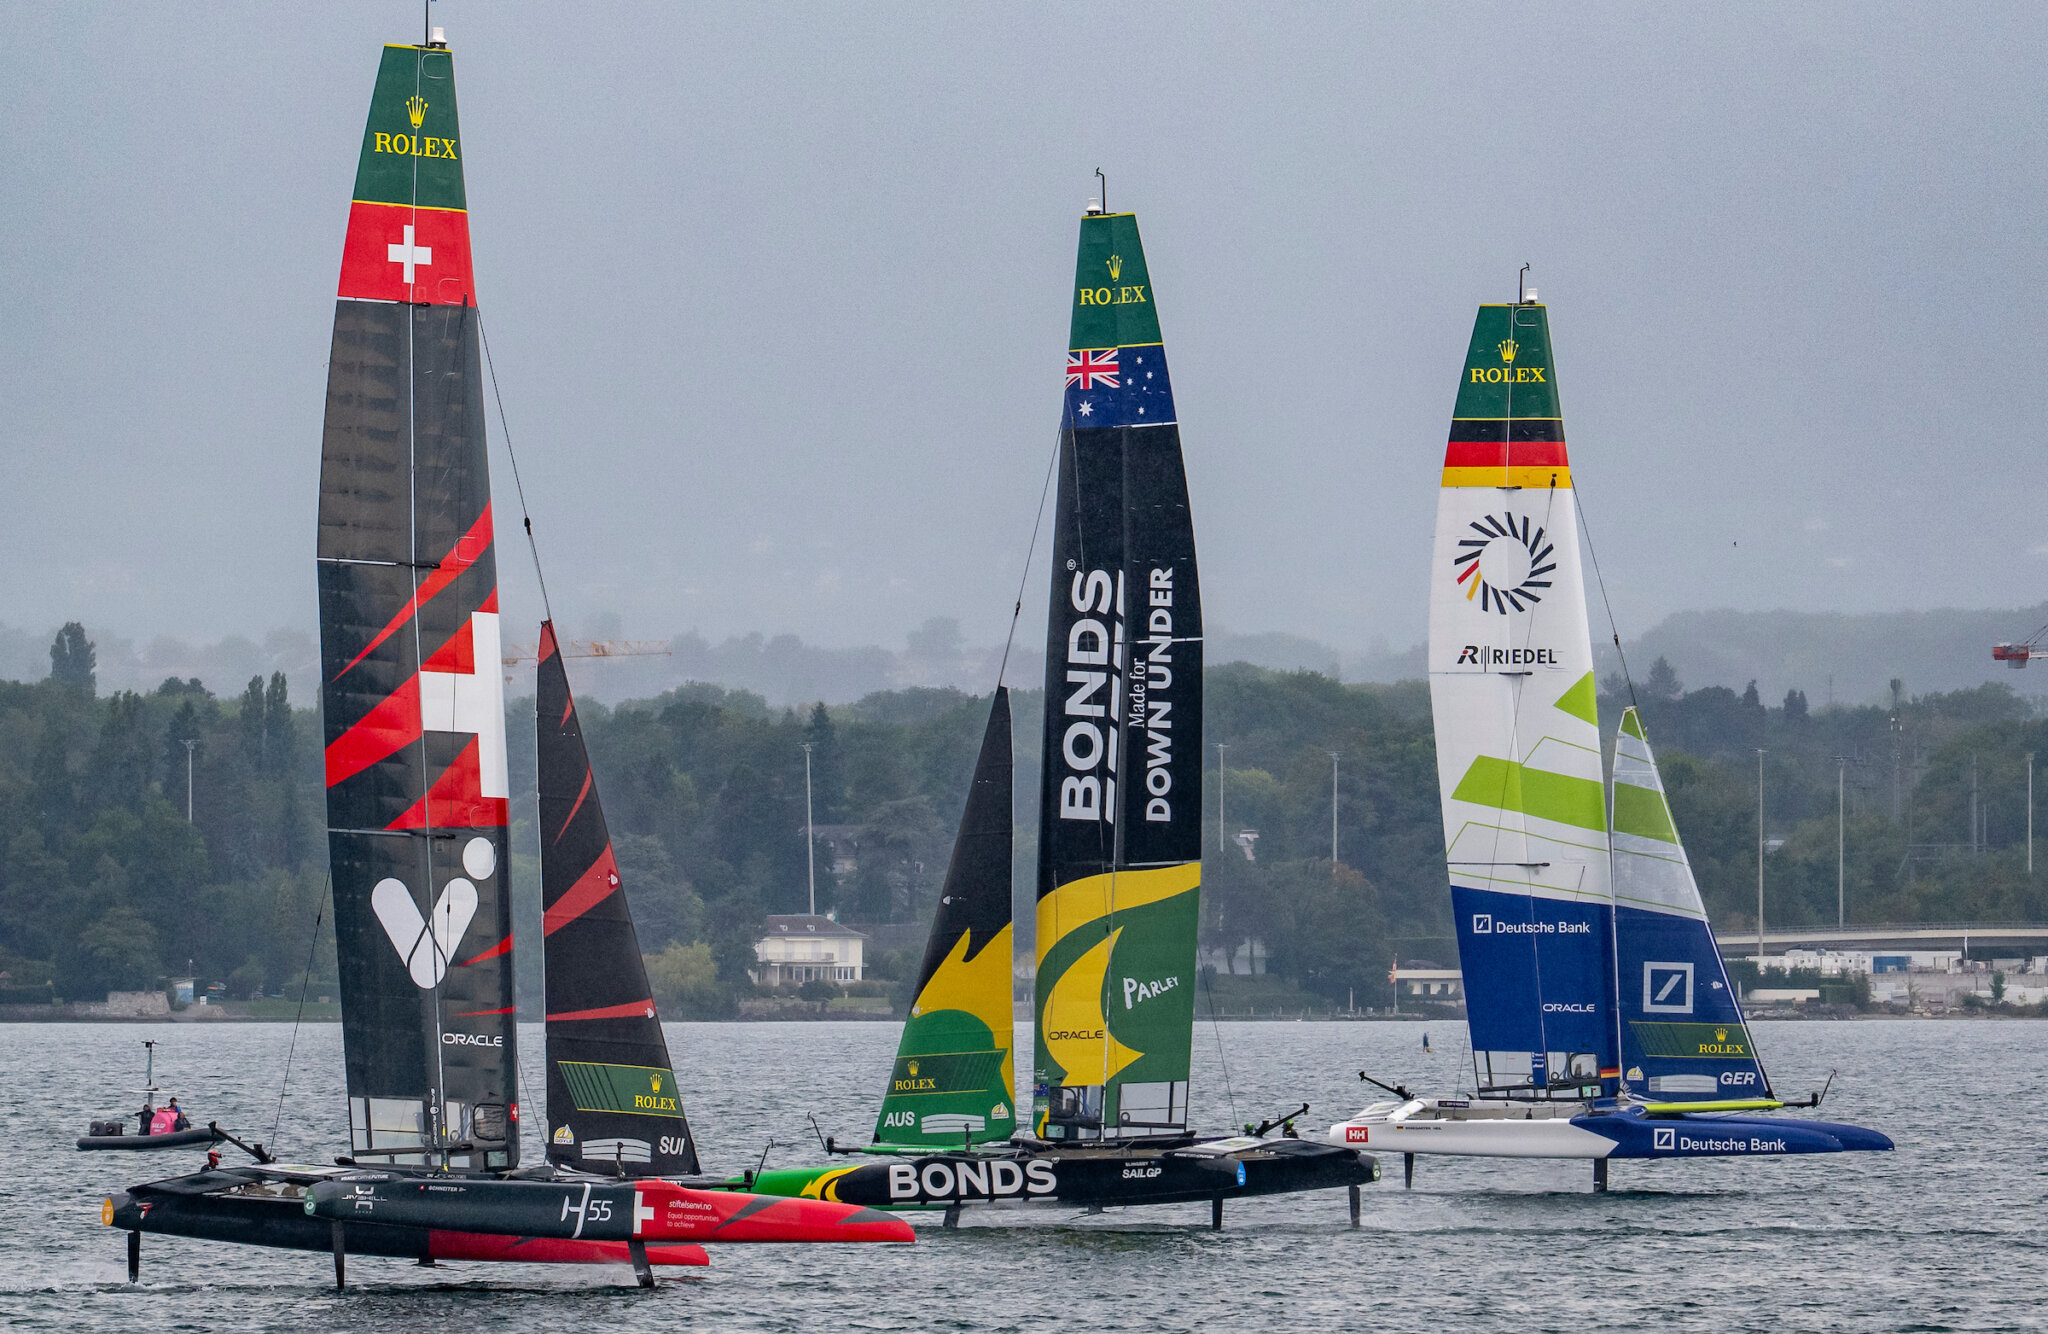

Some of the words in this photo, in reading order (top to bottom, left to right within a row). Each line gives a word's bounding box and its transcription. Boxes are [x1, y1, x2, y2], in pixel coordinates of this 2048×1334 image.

[374, 132, 458, 160] ROLEX
[1079, 285, 1147, 306] ROLEX
[1470, 367, 1547, 383] ROLEX
[1147, 567, 1173, 690] UNDER
[1493, 648, 1558, 665] RIEDEL
[1129, 657, 1146, 683] for
[1128, 684, 1146, 729] Made
[1145, 701, 1173, 822] DOWN
[1496, 921, 1556, 935] Deutsche
[1558, 921, 1591, 935] Bank
[1543, 1003, 1595, 1014] ORACLE
[442, 1033, 503, 1047] ORACLE
[1049, 1029, 1104, 1041] ORACLE
[1698, 1043, 1745, 1055] ROLEX
[895, 1078, 936, 1091] ROLEX
[1720, 1071, 1756, 1086] GER
[635, 1095, 677, 1111] ROLEX
[884, 1111, 916, 1128] AUS
[659, 1136, 686, 1156] SUI
[1680, 1136, 1748, 1152] Deutsche
[1750, 1136, 1786, 1152] Bank
[669, 1200, 712, 1211] stiftelsenvi.no
[667, 1212, 683, 1220] Equal
[684, 1213, 720, 1222] opportunities
[674, 1221, 695, 1229] achieve
